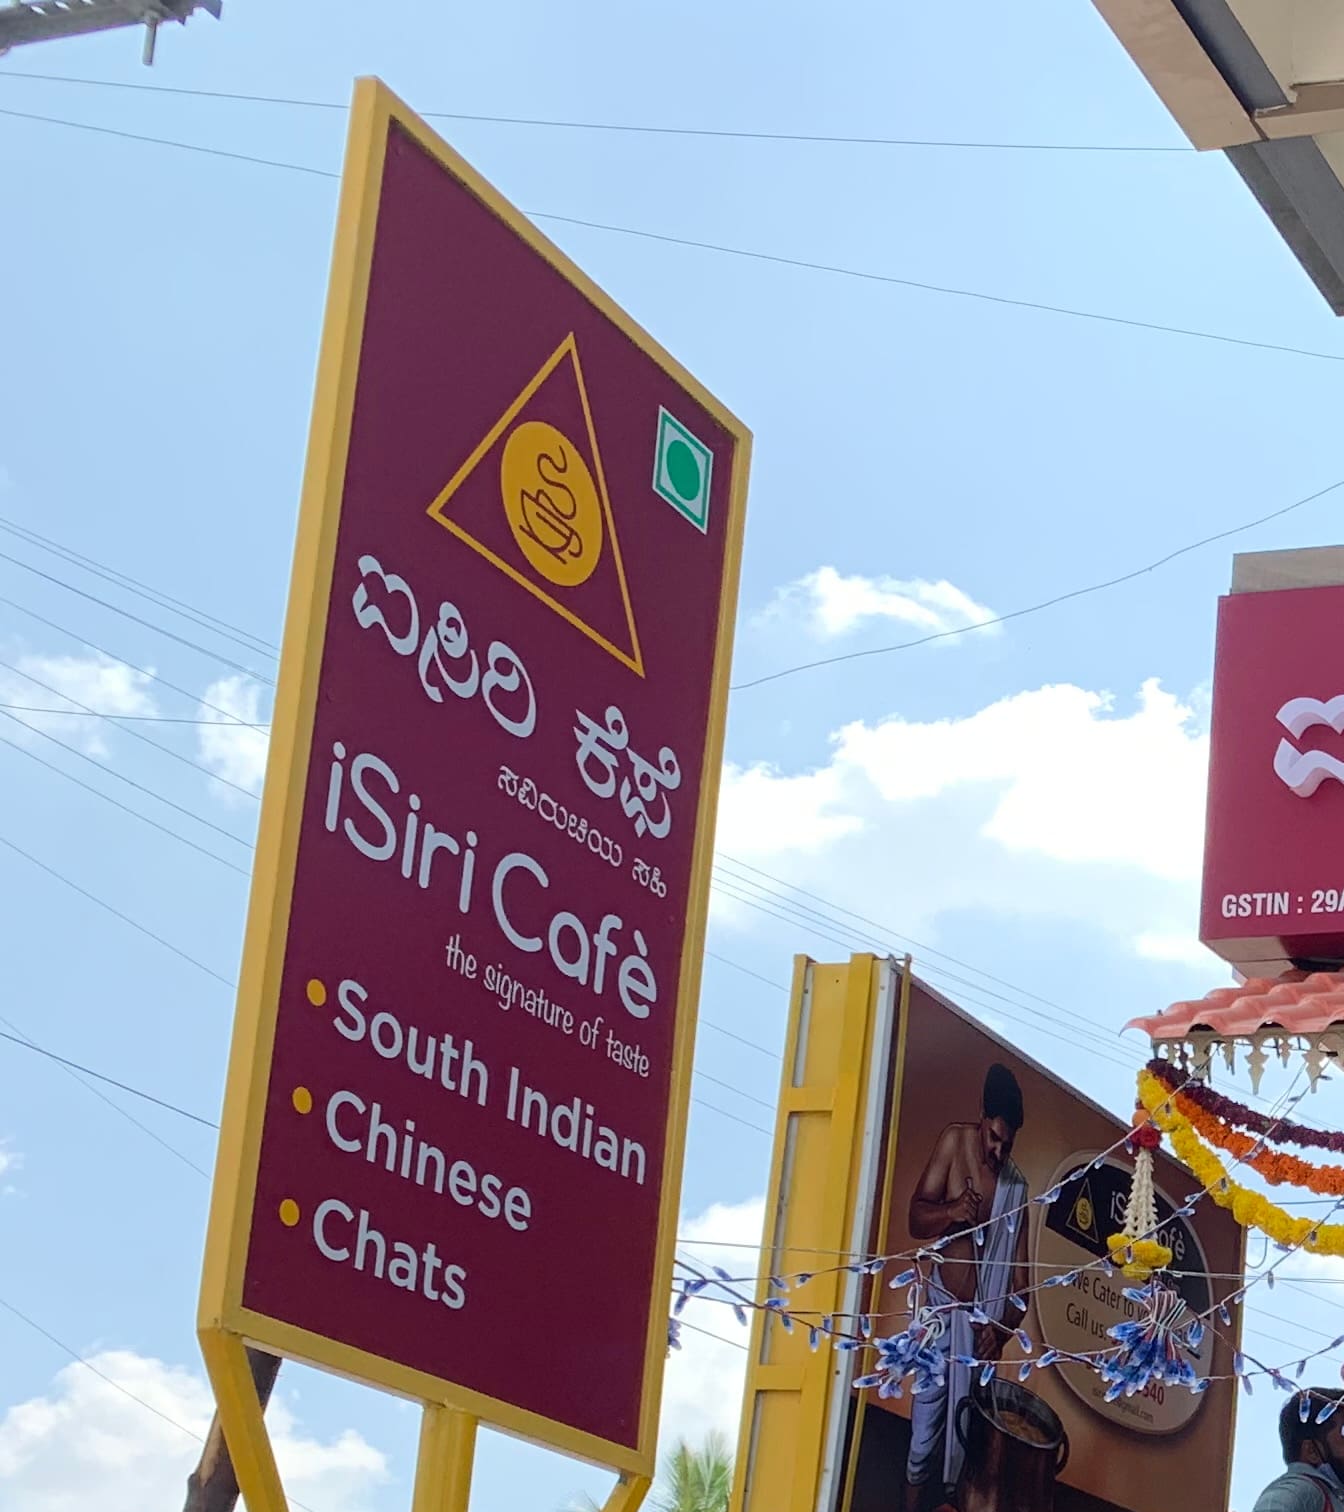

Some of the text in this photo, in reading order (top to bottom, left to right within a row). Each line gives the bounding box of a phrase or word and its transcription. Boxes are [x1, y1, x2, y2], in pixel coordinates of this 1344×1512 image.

[325, 742, 658, 1019] iSiri Cafè
[1221, 891, 1290, 919] GSTIN
[445, 933, 650, 1078] the signature of taste
[334, 979, 647, 1186] South Indian
[326, 1090, 532, 1232] Chinese
[312, 1199, 468, 1311] Chats
[1066, 1302, 1088, 1330] Call
[1089, 1277, 1120, 1310] Cater
[1124, 1294, 1134, 1318] to
